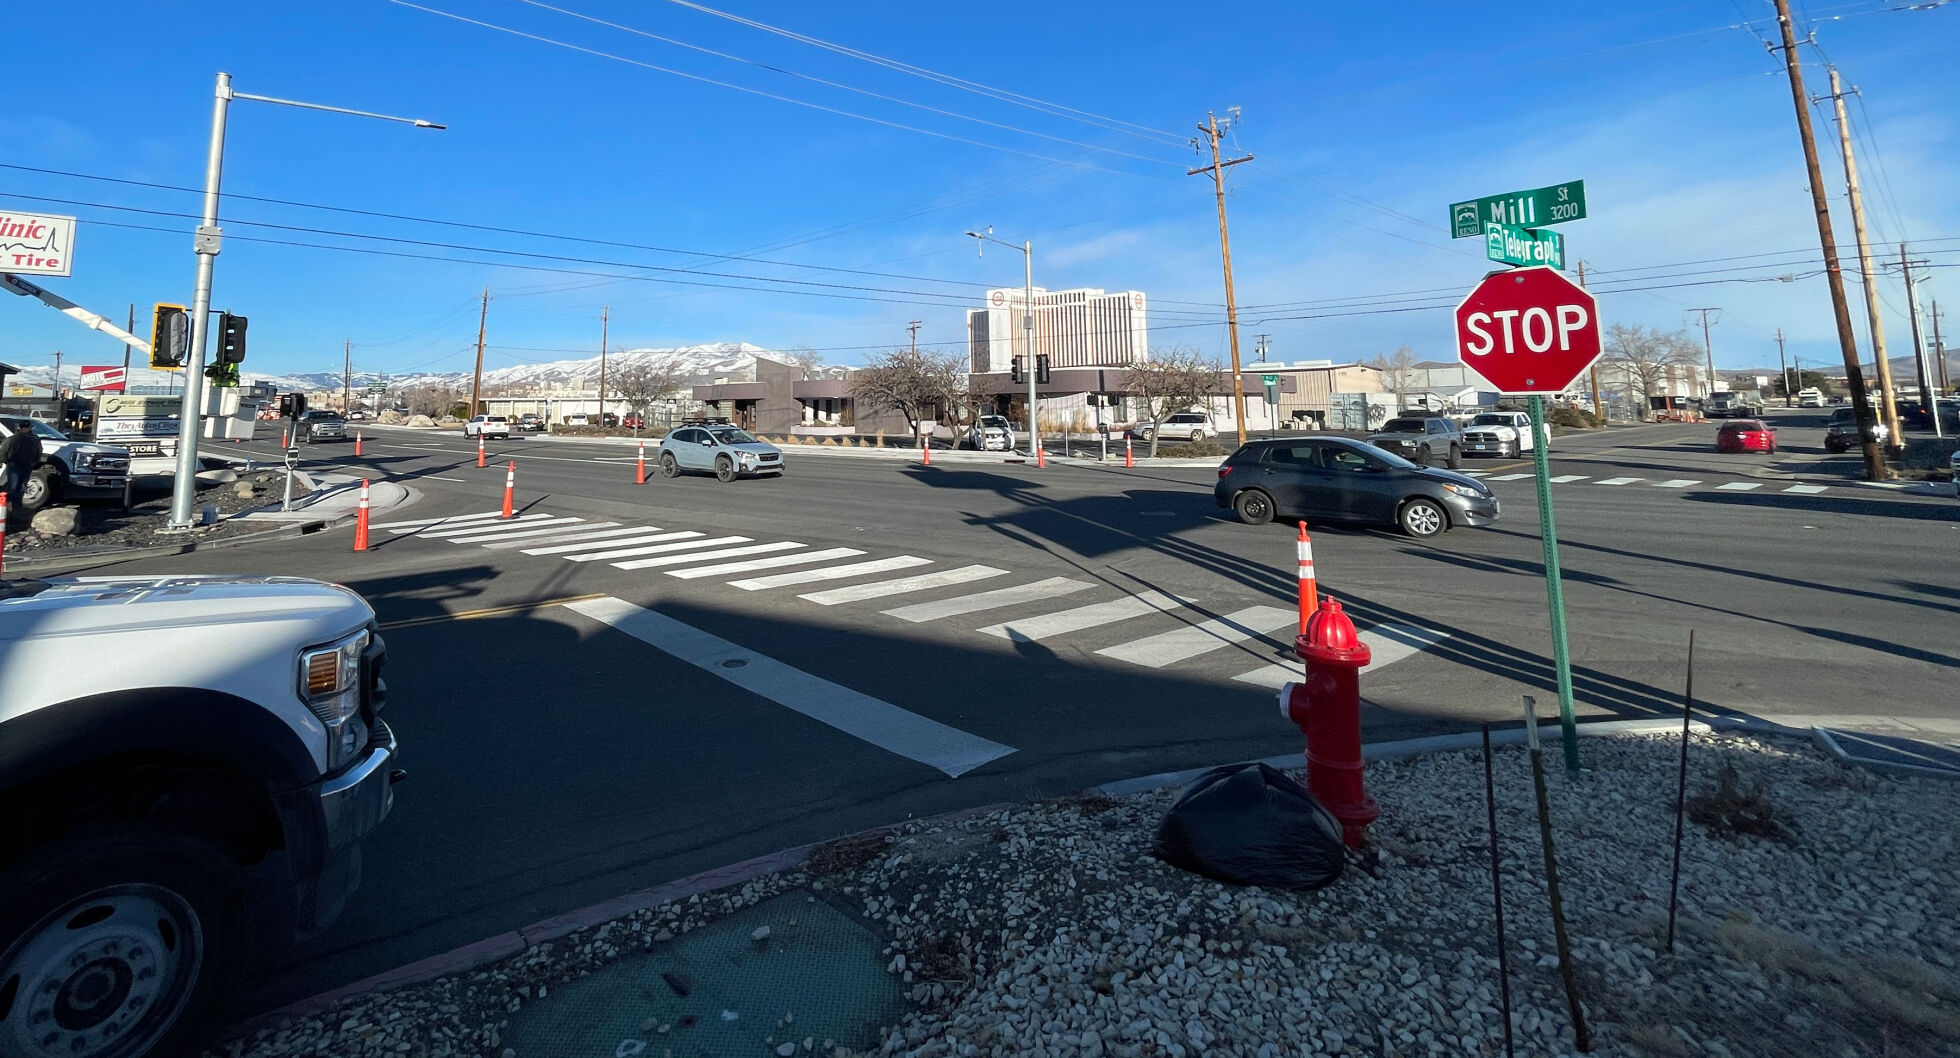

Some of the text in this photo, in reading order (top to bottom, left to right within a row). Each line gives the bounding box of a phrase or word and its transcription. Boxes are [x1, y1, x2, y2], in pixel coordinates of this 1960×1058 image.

[1557, 187, 1569, 201] St
[1490, 197, 1535, 224] Mill
[1550, 202, 1578, 221] 3200
[11, 253, 59, 268] Tire
[1466, 304, 1588, 356] STOP
[129, 445, 158, 453] STORE
